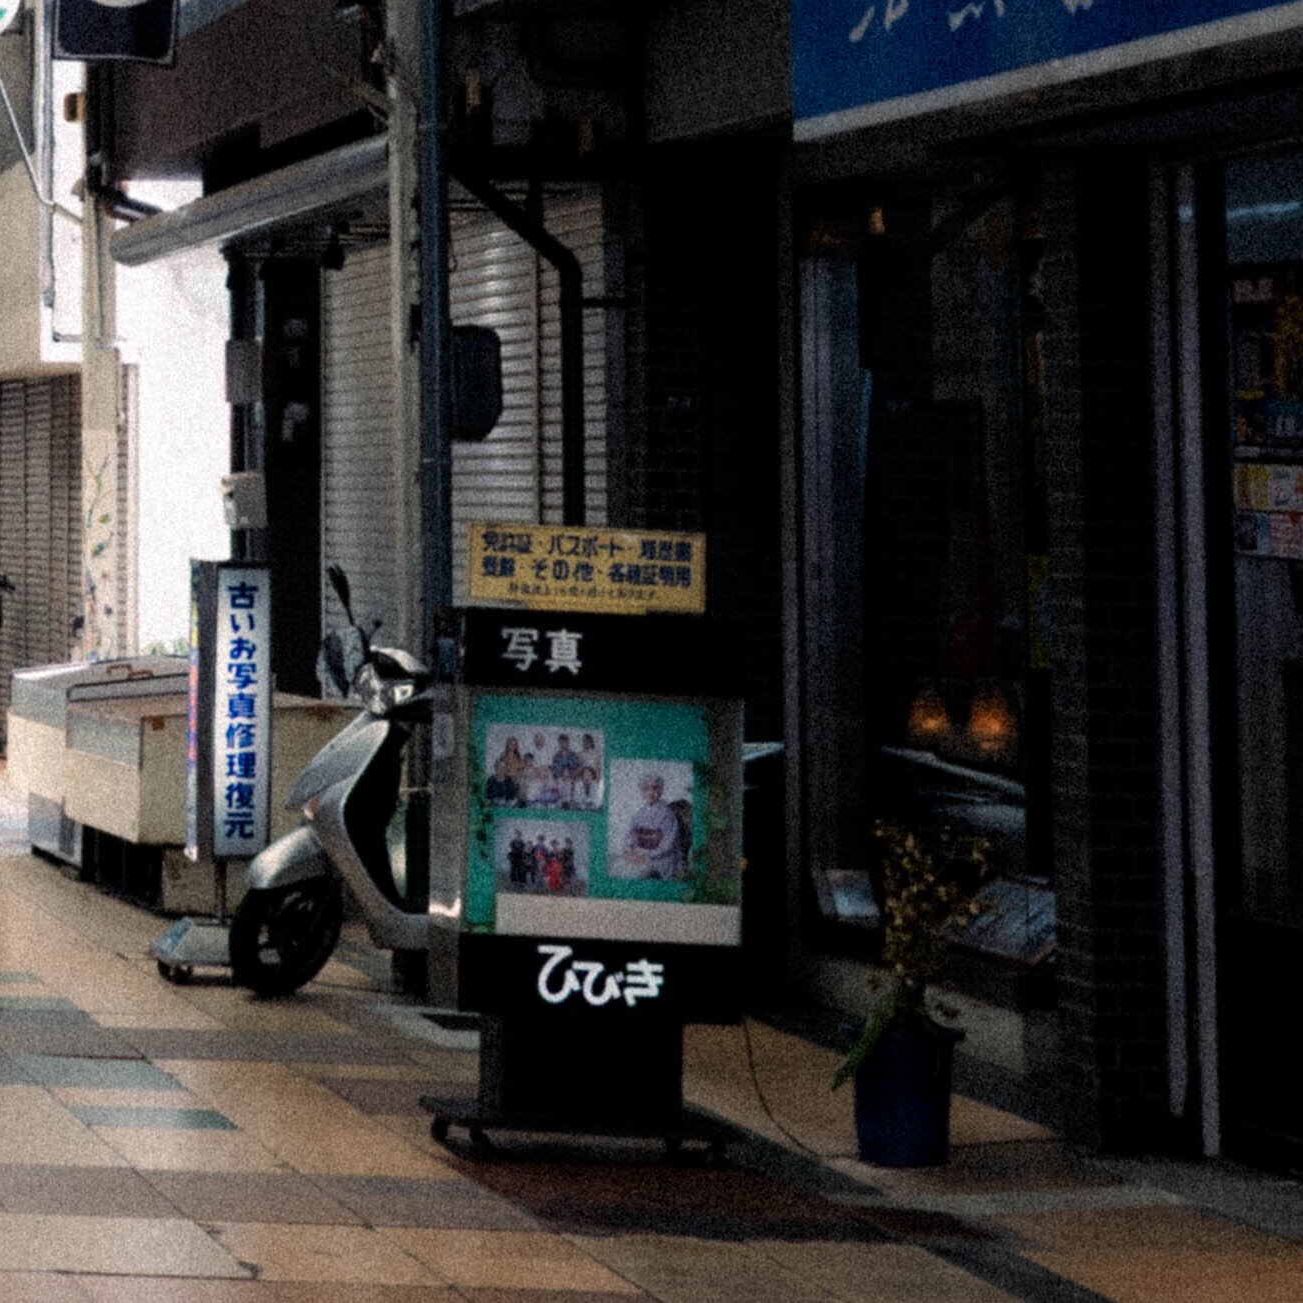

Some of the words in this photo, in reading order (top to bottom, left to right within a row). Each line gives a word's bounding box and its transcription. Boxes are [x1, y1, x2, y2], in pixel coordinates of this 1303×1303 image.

[500, 626, 584, 676] 写真
[224, 582, 258, 839] 古いお写真修理復元
[536, 943, 666, 1008] ひびき
